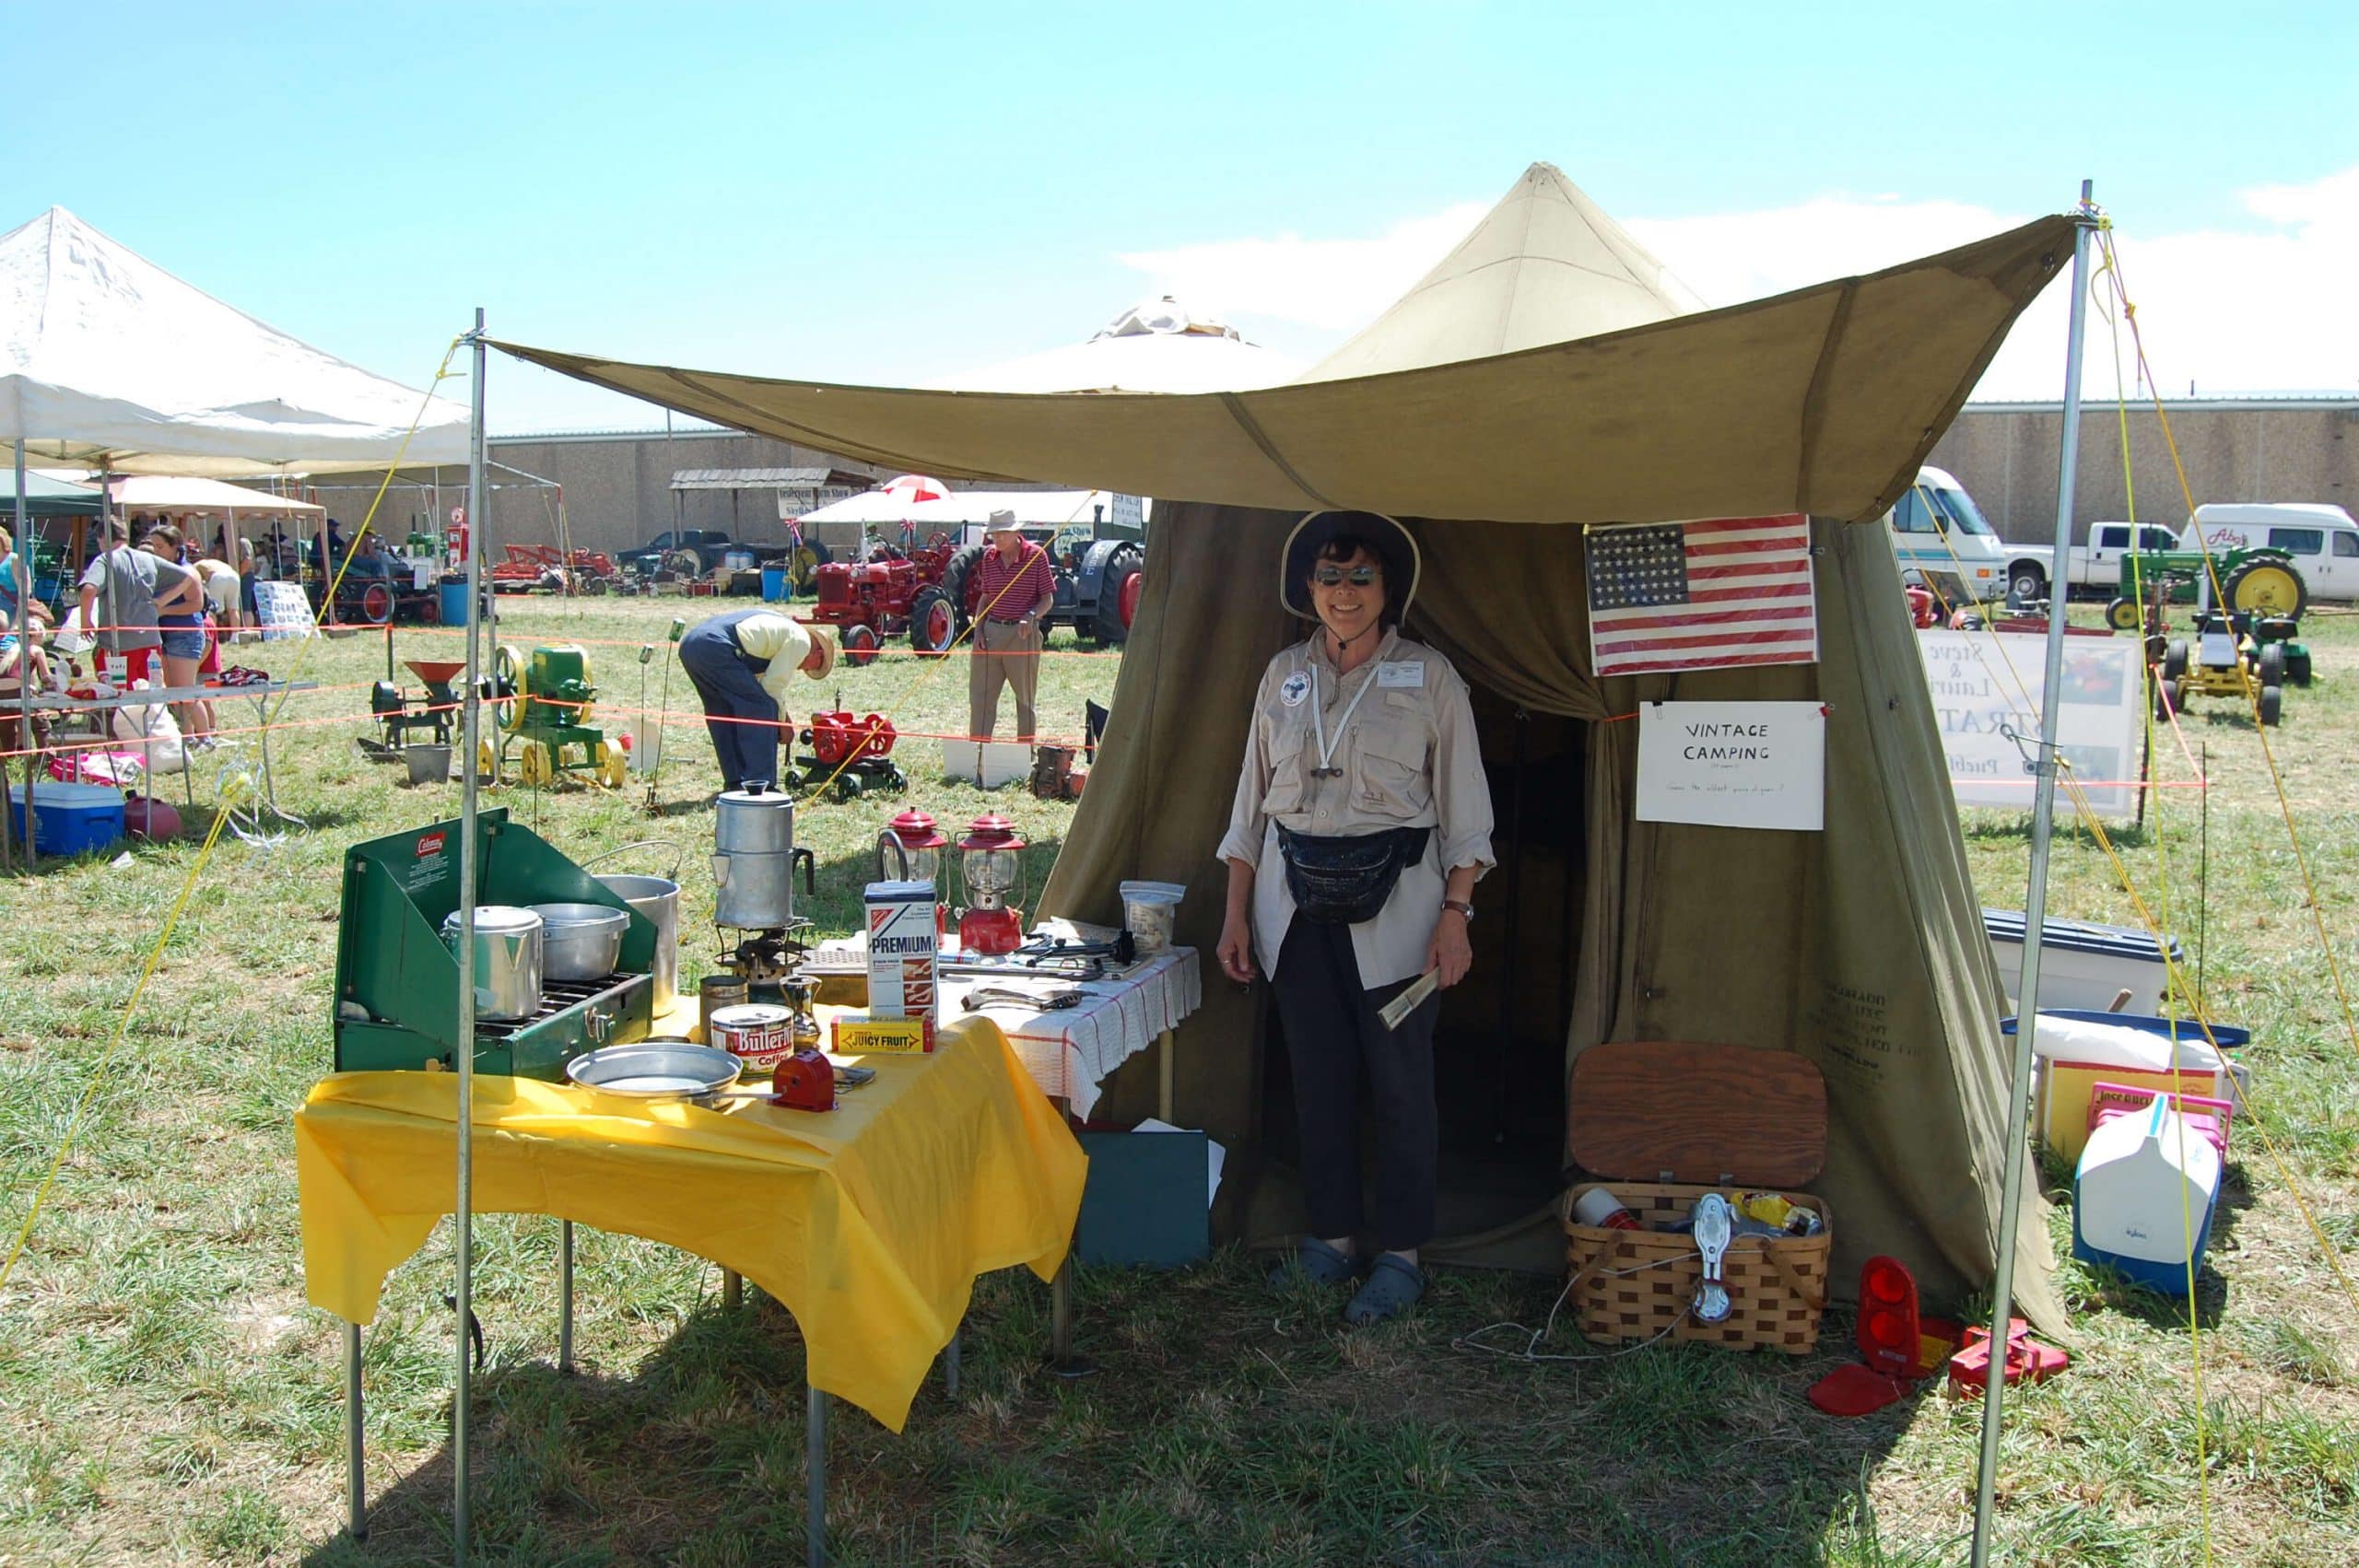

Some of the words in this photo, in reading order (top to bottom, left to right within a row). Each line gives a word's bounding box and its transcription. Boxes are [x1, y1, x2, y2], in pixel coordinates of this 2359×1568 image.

[1685, 723, 1768, 737] VINTAGE
[1684, 745, 1769, 760] CAMPING
[872, 935, 933, 954] PREMIUM
[851, 1036, 881, 1047] JUICY
[881, 1036, 909, 1047] FRUIT
